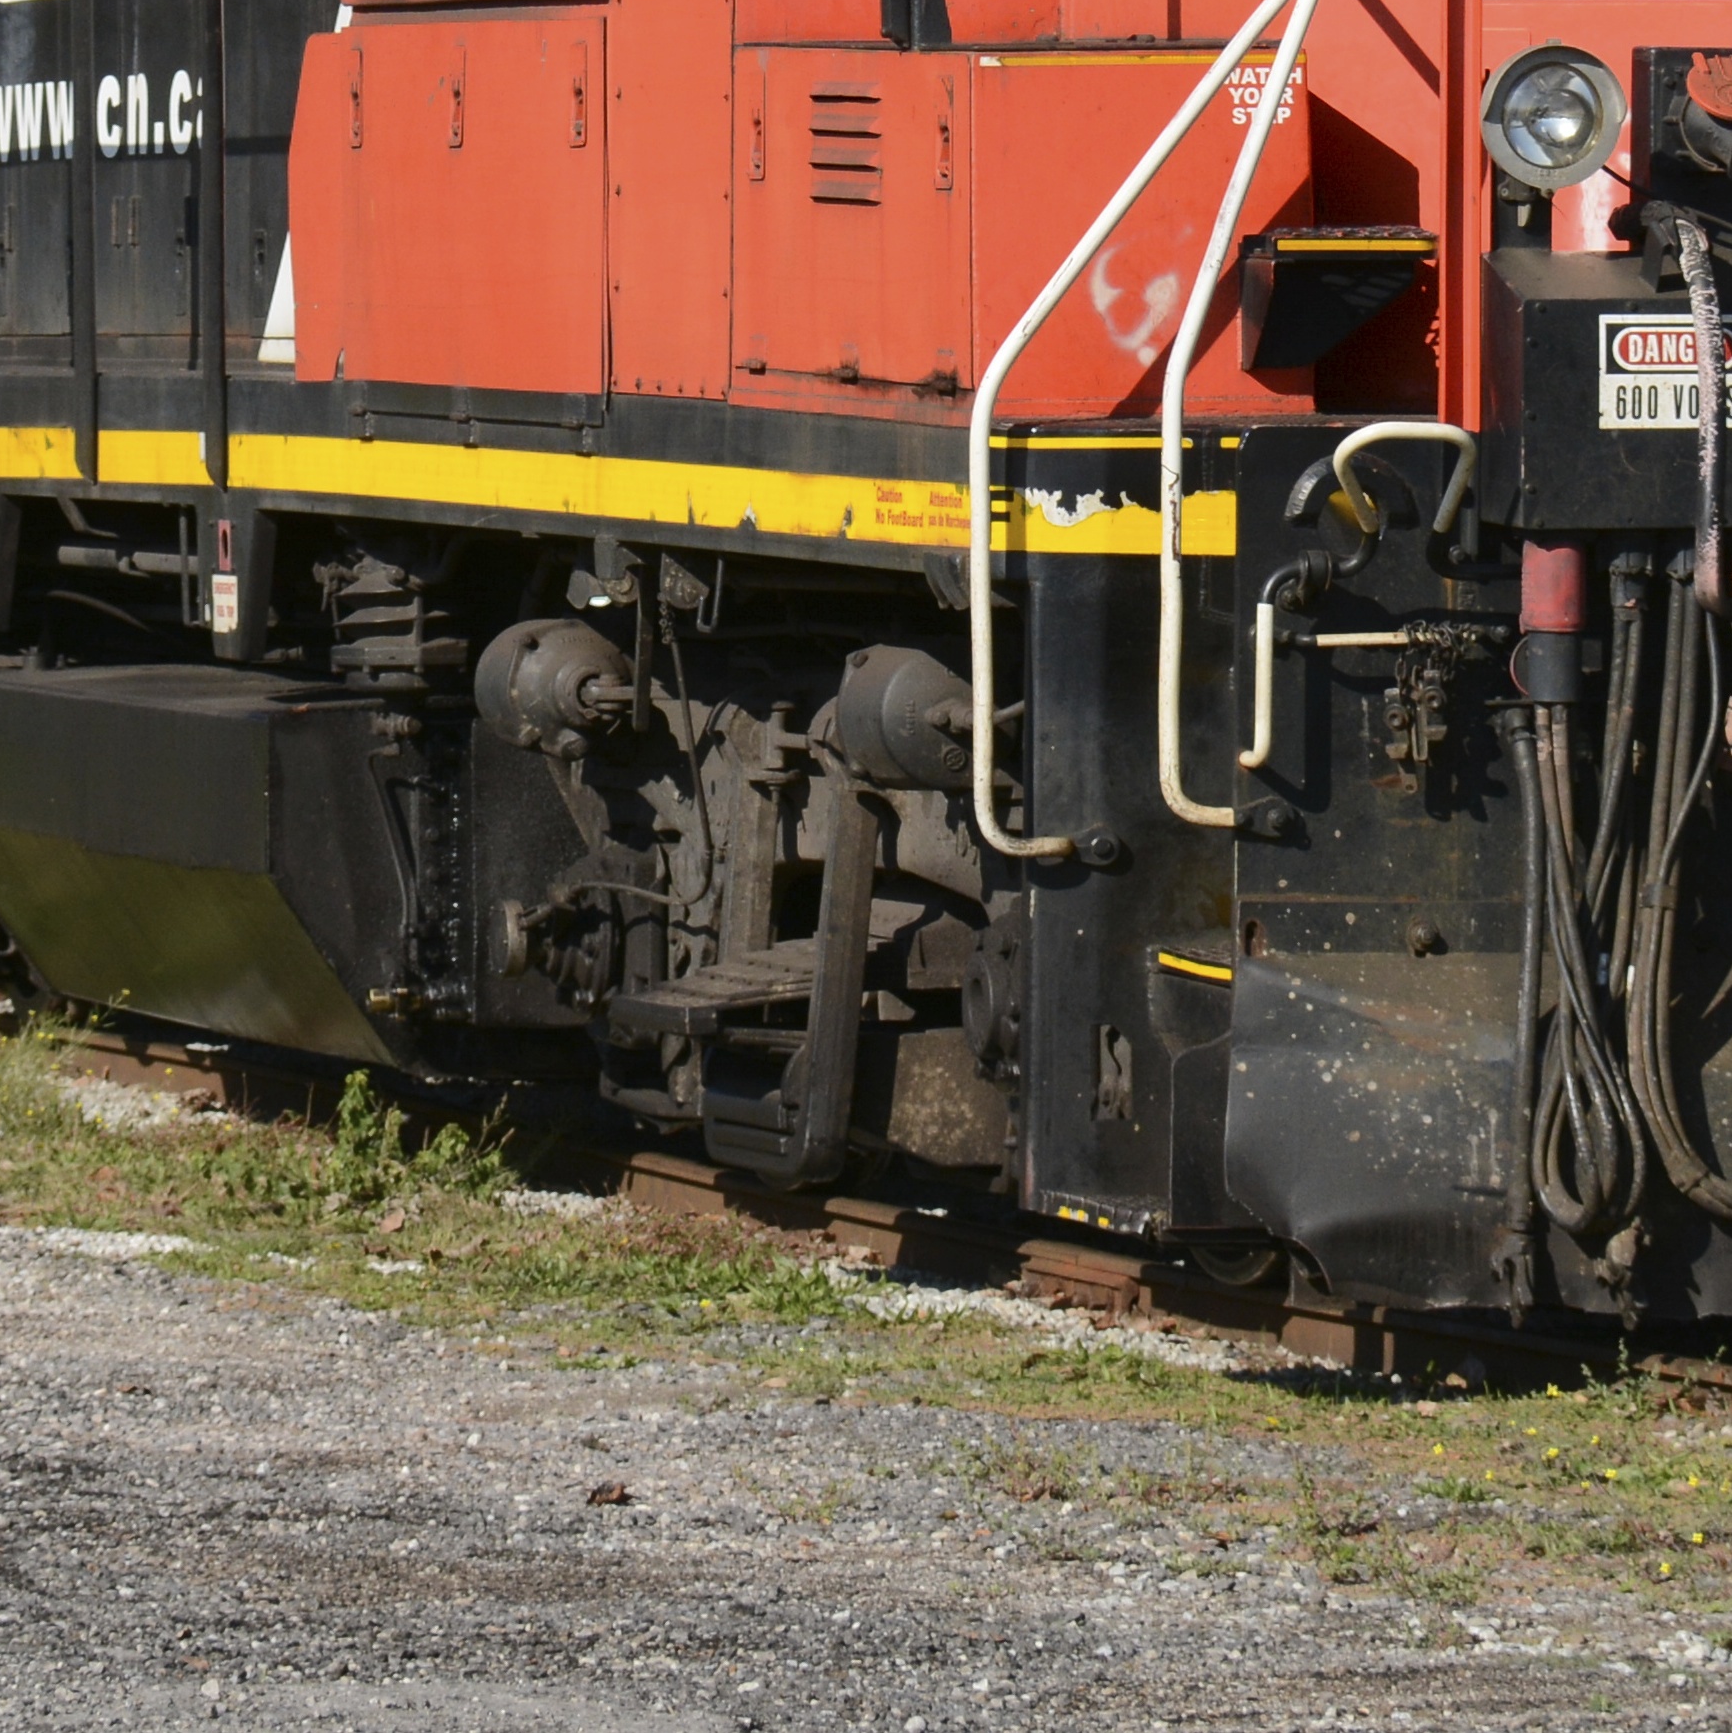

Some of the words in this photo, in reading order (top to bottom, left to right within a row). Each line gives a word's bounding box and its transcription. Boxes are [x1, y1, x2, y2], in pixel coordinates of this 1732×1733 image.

[1228, 87, 1294, 104] YOR
[1627, 333, 1695, 363] DANG
[1616, 385, 1658, 420] 600
[876, 486, 903, 503] Caution
[929, 491, 963, 509] Attention
[875, 508, 885, 524] No
